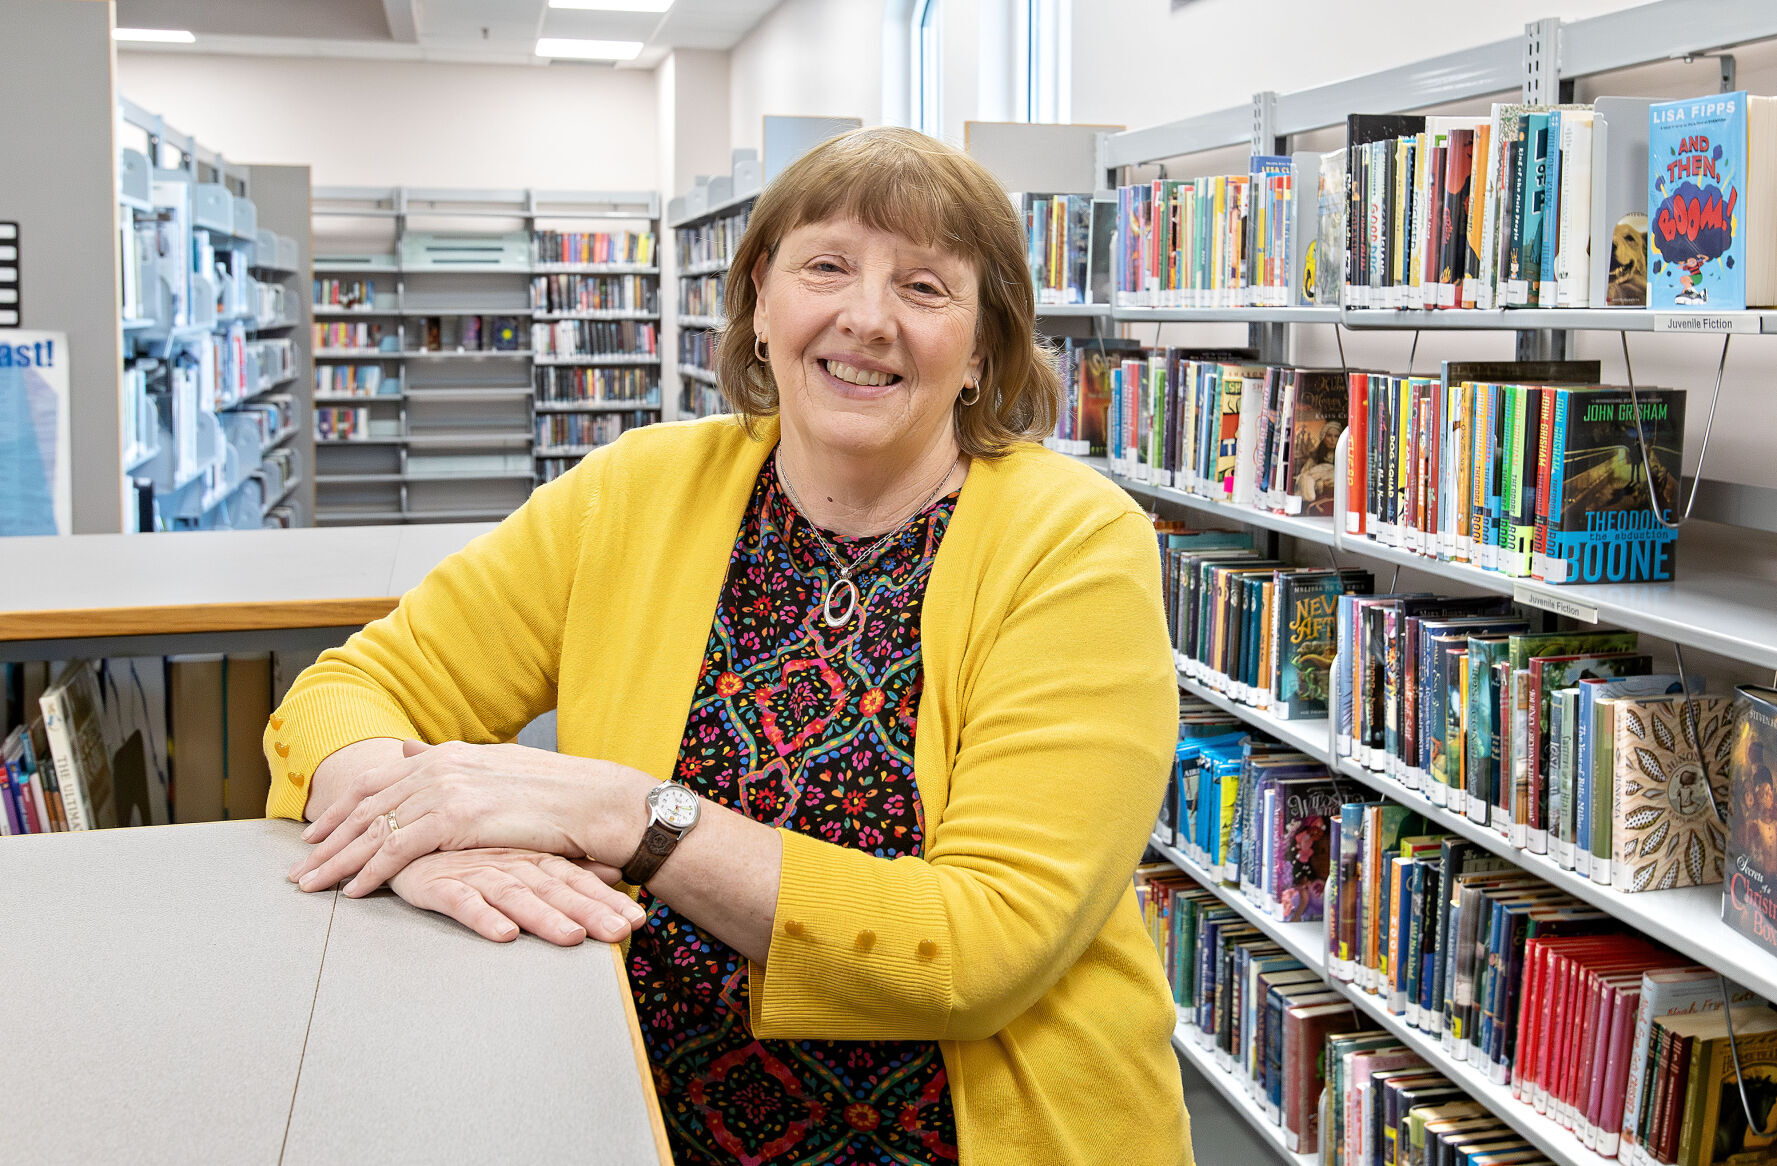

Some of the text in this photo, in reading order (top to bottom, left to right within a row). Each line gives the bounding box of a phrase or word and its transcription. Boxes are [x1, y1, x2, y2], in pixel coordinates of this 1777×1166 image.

[1653, 108, 1684, 124] LISA
[1691, 101, 1735, 119] FIPPS
[1678, 135, 1710, 156] AND
[1667, 155, 1721, 184] THEN,
[1370, 203, 1378, 242] GOOD
[1658, 186, 1737, 242] BOOM!
[1667, 318, 1733, 329] Juvenile Fiction
[1584, 404, 1614, 422] JOHN
[1538, 392, 1550, 467] JOHN GRISHAM
[1552, 398, 1564, 470] JOHN GRISHAM
[1585, 508, 1672, 532] THEODORE
[1507, 526, 1516, 550] BOO
[1546, 531, 1556, 556] BOO
[1590, 532, 1607, 541] the
[1562, 539, 1673, 583] BOONE
[1289, 595, 1338, 630] NEV
[1528, 594, 1580, 616] Juvenile Fiction
[1290, 617, 1336, 644] AFT
[1578, 723, 1587, 741] The
[1578, 742, 1586, 761] Year
[1578, 763, 1586, 776] of
[56, 754, 82, 831] THE ULTIMA
[1736, 853, 1764, 883] Secrets
